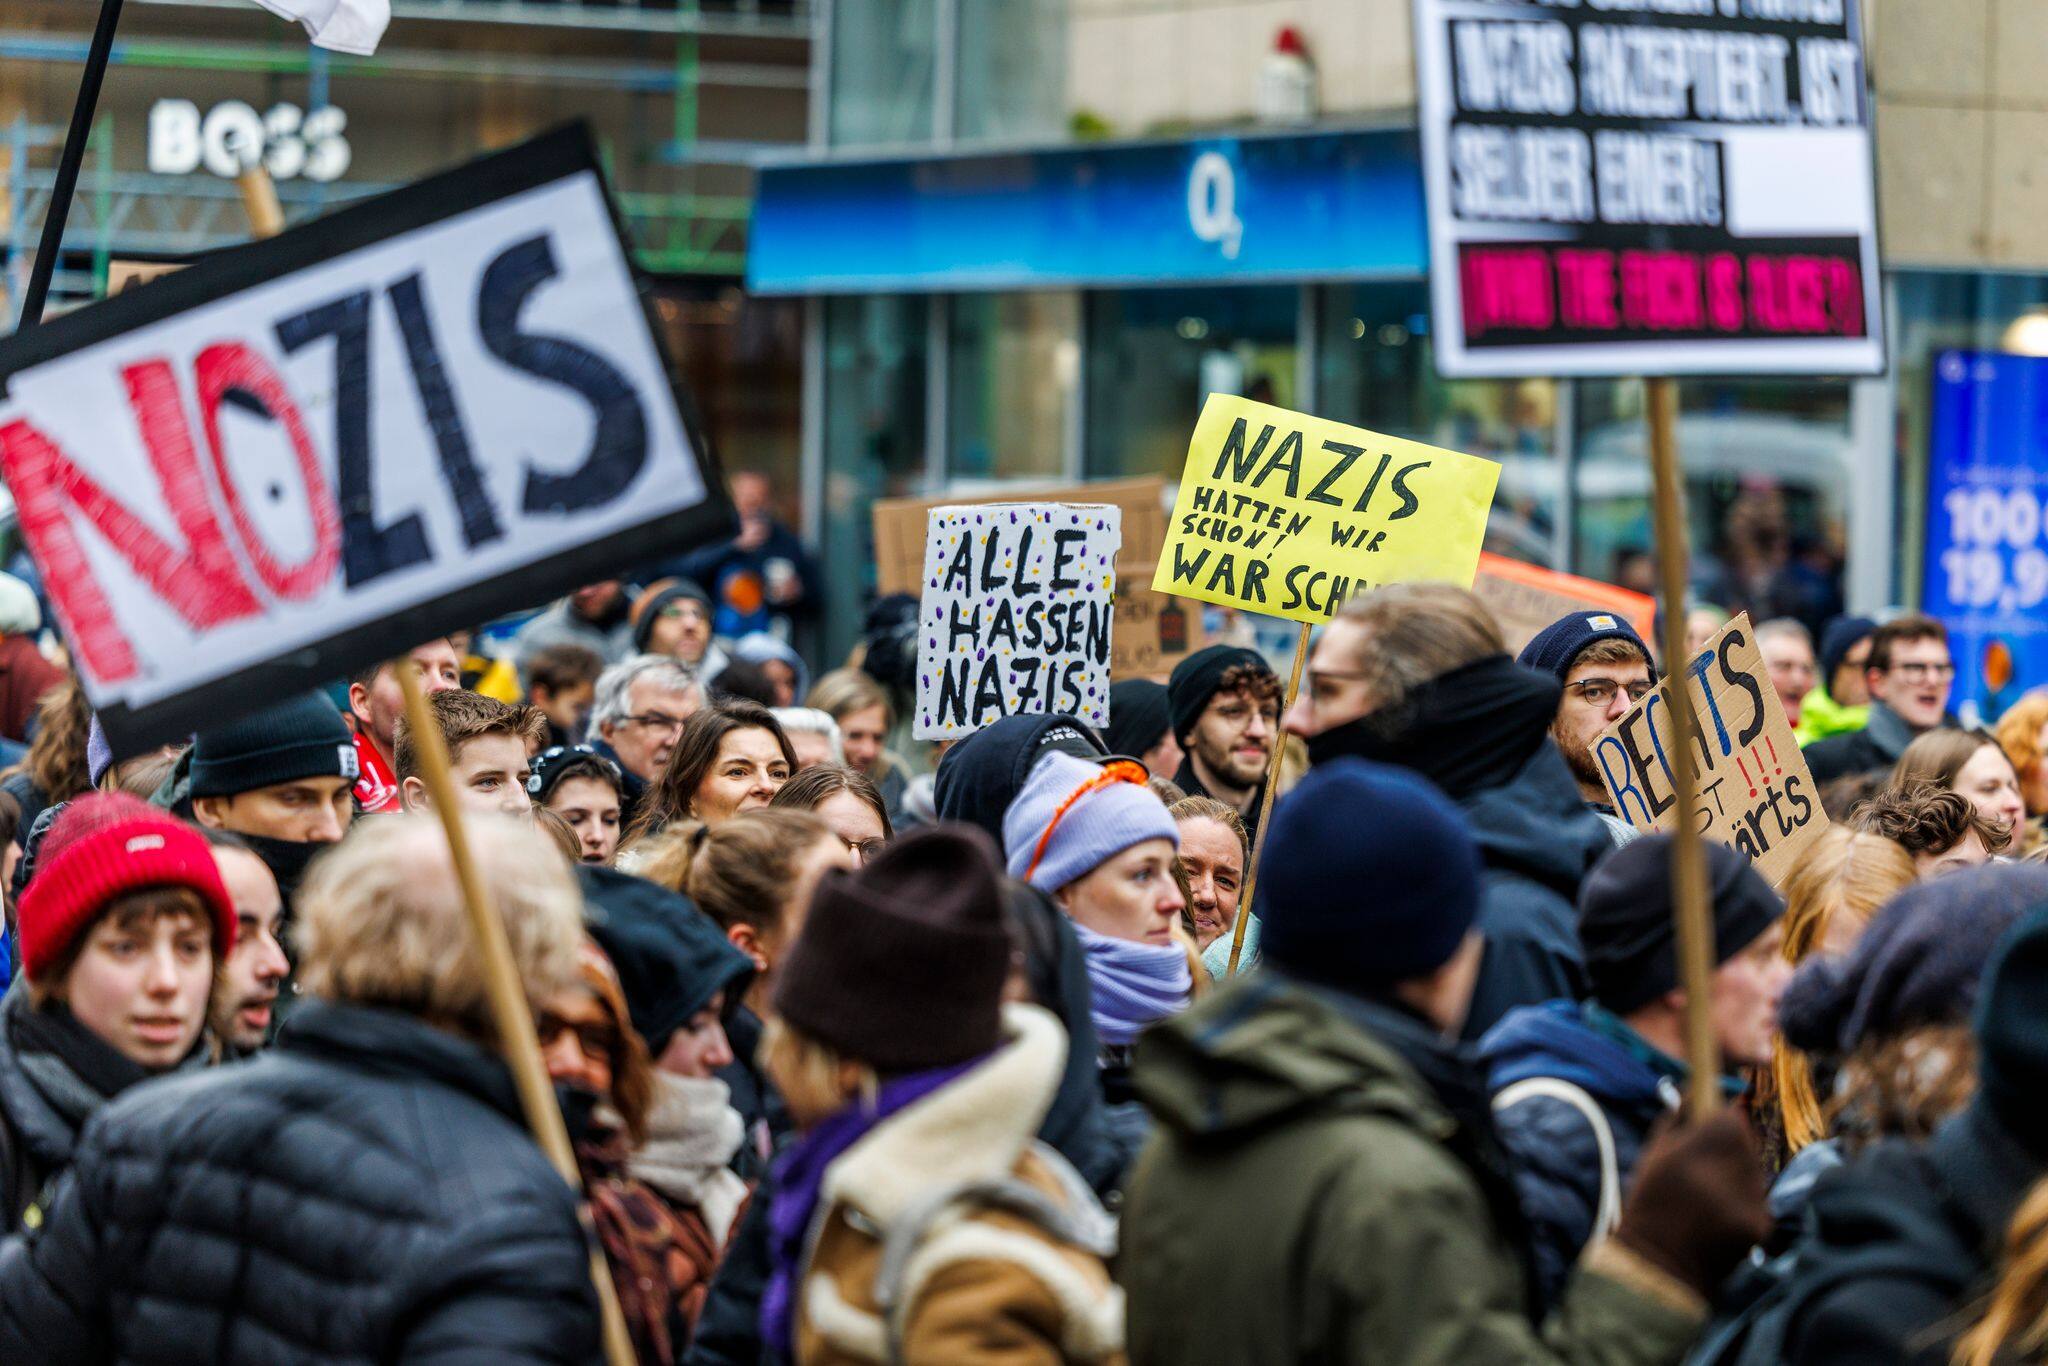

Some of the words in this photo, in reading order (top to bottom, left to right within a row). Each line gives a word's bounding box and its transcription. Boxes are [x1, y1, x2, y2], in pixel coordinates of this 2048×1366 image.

[148, 98, 352, 182] BOSS
[0, 233, 650, 682] NOZIS
[1212, 417, 1432, 520] NAZIS
[1182, 513, 1288, 560] SCHON!
[1193, 486, 1312, 536] HATTEN
[1331, 520, 1387, 552] WIR
[943, 525, 1087, 599] ALLE
[1173, 542, 1271, 603] WAR
[948, 598, 1111, 665] HASSEN
[937, 654, 1086, 726] NAZIS
[1723, 775, 1812, 859] ärts
